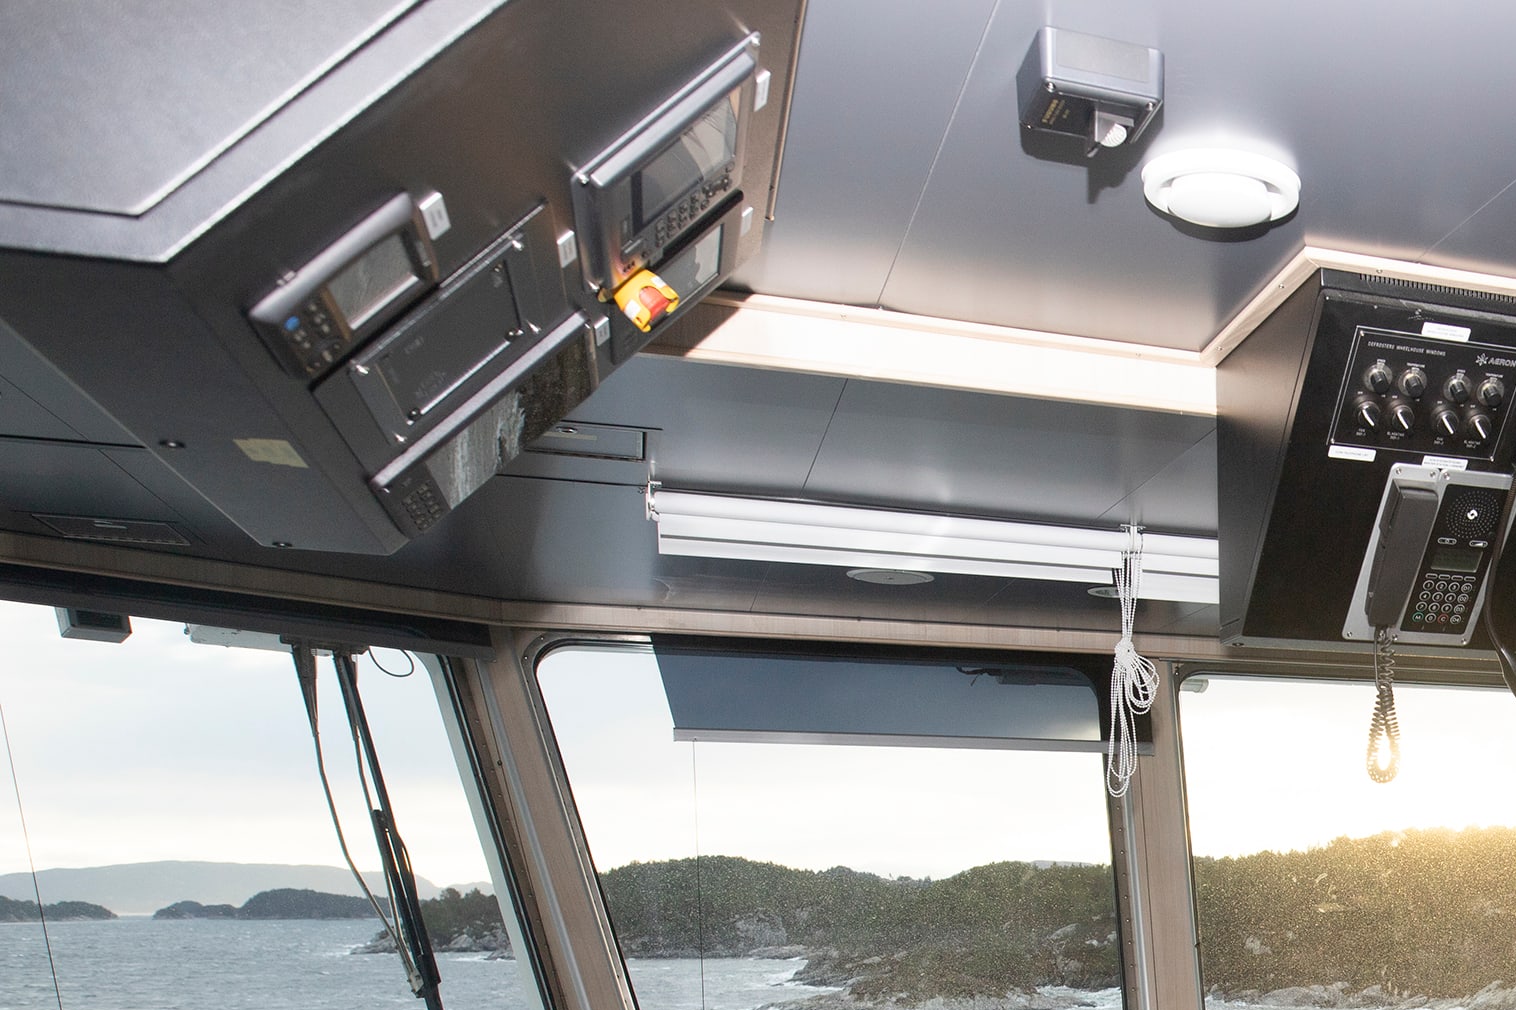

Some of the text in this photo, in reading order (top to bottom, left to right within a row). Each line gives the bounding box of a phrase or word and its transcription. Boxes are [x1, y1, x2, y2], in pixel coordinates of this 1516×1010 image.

[1367, 340, 1447, 357] DEFROSTERS WHEELHOUSE WINDOWS
